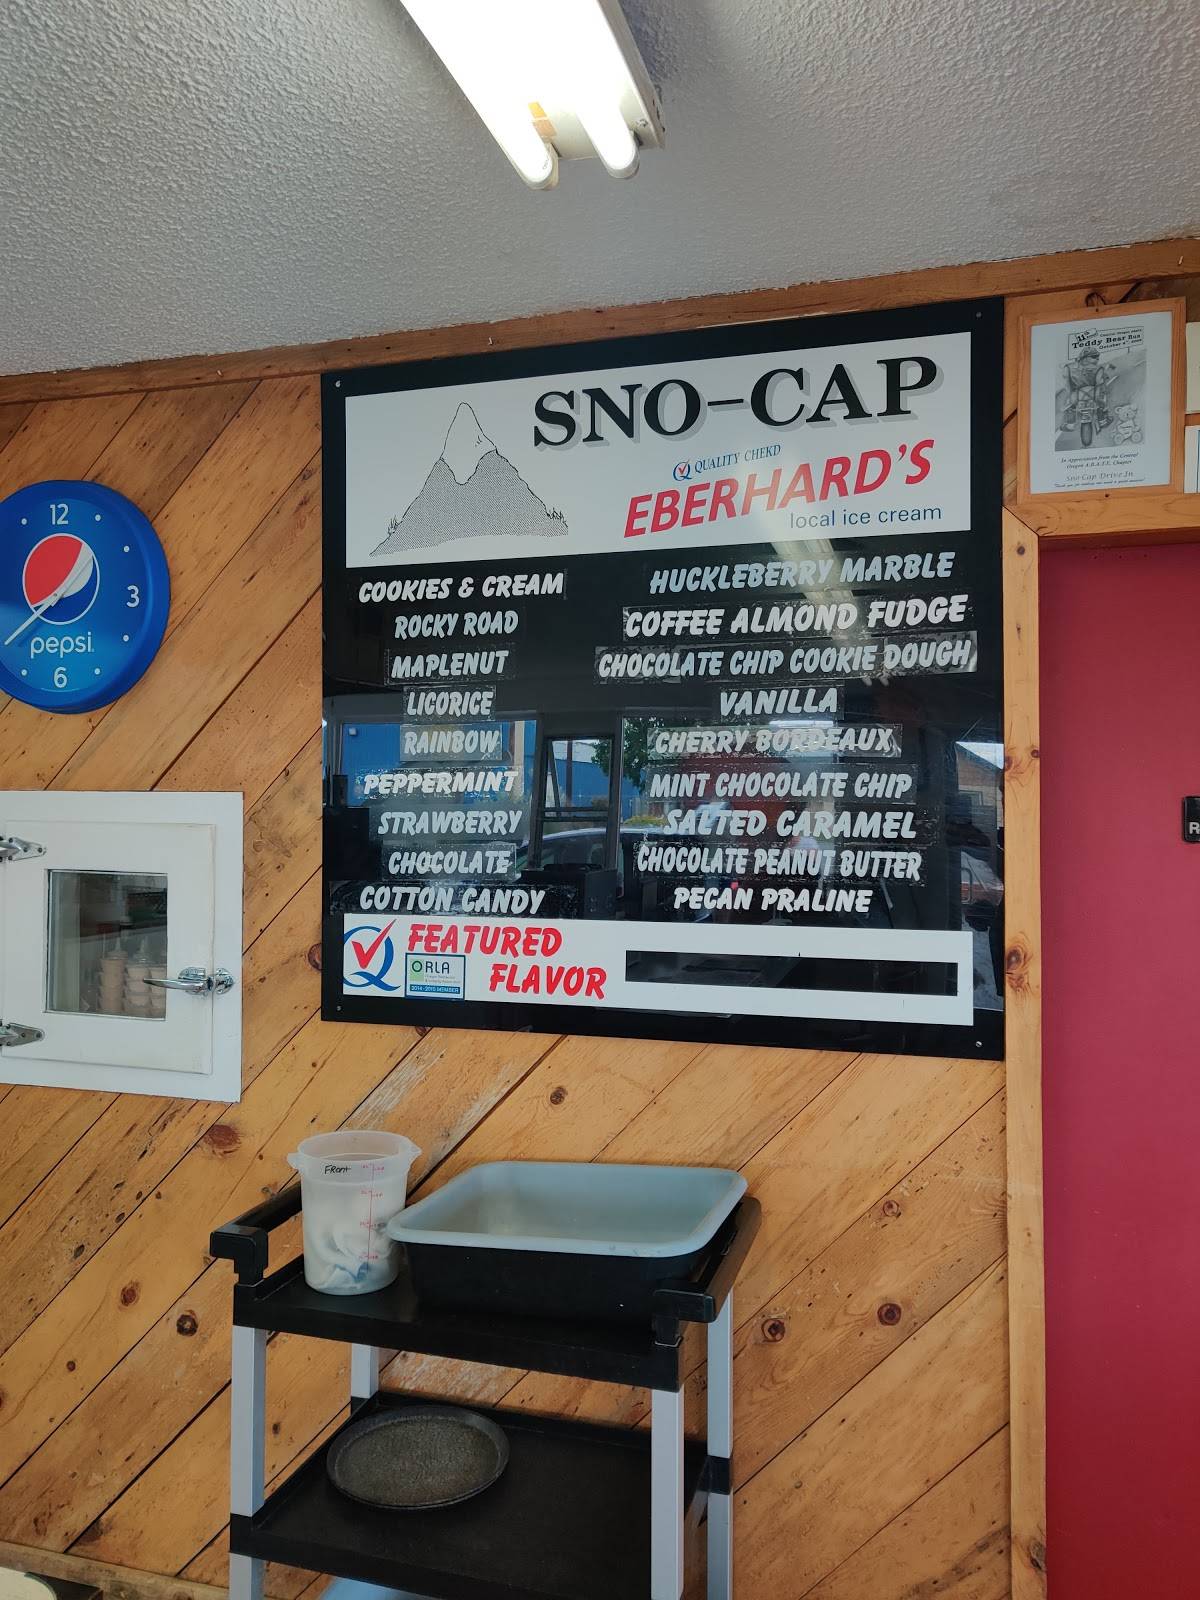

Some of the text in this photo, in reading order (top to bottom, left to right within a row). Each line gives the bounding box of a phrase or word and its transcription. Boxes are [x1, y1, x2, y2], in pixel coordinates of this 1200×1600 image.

[1072, 339, 1103, 350] Teddy
[1106, 335, 1127, 344] Bear
[694, 453, 740, 474] QUALITY
[744, 444, 782, 462] CHEKD
[623, 439, 936, 538] EBERHARD'S
[49, 503, 69, 525] 12
[790, 506, 942, 529] local ice cream
[649, 551, 956, 594] HUCKLEBERRY MARBLE
[126, 585, 140, 608] 3
[358, 572, 564, 604] COOKIES & CREAM
[394, 610, 519, 641] ROCKY ROAD
[625, 594, 969, 638] COFFEE ALMOND FUDGE
[30, 631, 93, 659] pepsi
[598, 638, 972, 679] CHOCOLATE CHIP COOKIE DOUGH
[53, 666, 68, 689] 6
[390, 650, 510, 679] MAPLENUT
[406, 690, 494, 717] LICORICE
[719, 686, 838, 717] VANILLA
[404, 730, 501, 756] RAINBOW
[655, 727, 893, 754] CHERRY BORDEAUX
[363, 771, 519, 795] PEPPERMINT
[649, 772, 913, 799] MINT CHOCOLATE CHIP
[377, 810, 523, 836] STRAWBERRY
[662, 808, 917, 840] SALTED CARAMEL
[388, 850, 512, 875] CHOCOLATE
[637, 845, 922, 882] CHOCOLATE PEANUT BUTTER
[359, 885, 546, 914] COTTON CANDY
[673, 886, 873, 913] PECAN PRALINE
[407, 923, 563, 958] FEATURED
[411, 960, 450, 974] ORLA
[489, 963, 608, 1000] FLAVOR
